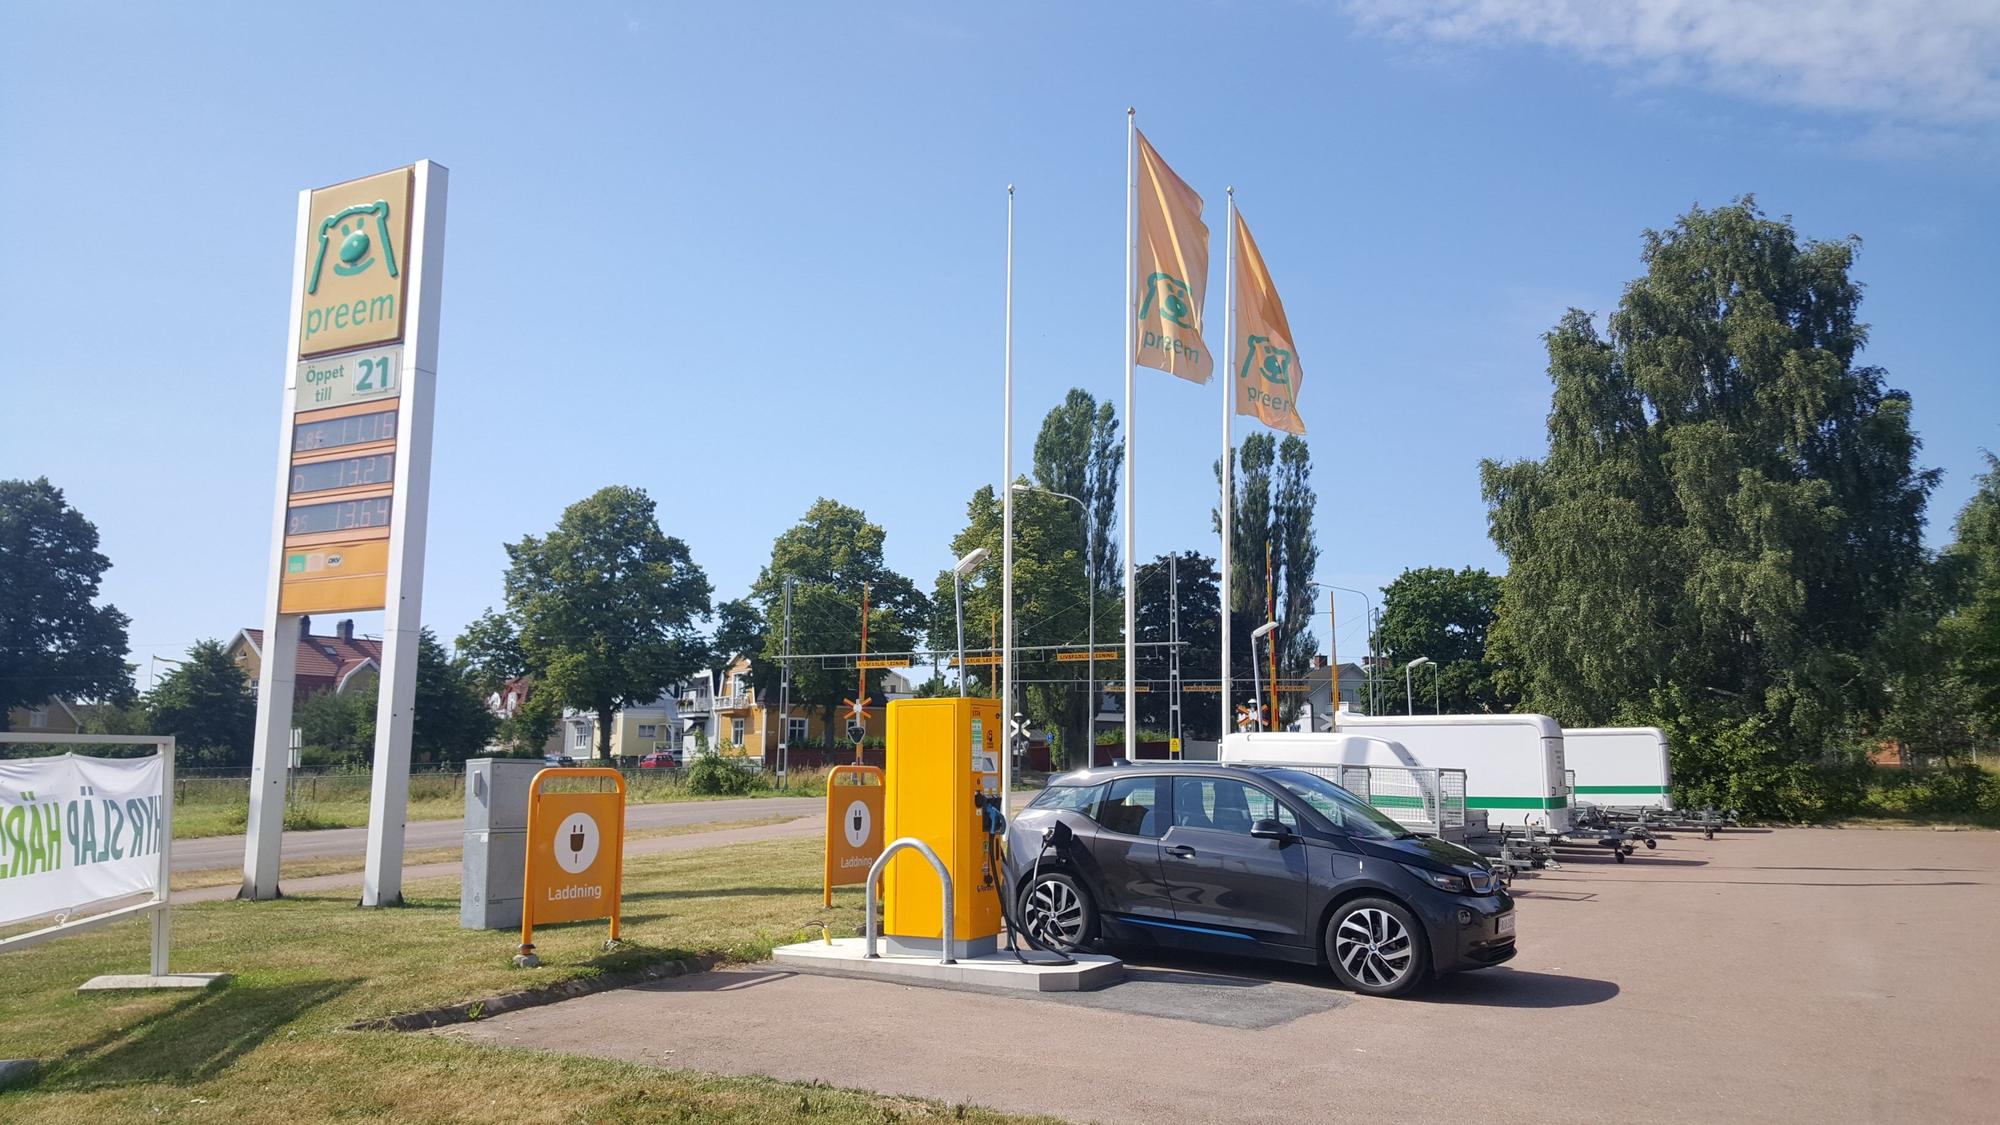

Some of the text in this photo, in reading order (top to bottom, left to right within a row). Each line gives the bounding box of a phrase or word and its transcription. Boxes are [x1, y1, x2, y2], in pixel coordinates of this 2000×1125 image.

[305, 293, 395, 341] preem
[1143, 330, 1200, 364] preem
[306, 365, 345, 386] Öppet
[356, 356, 390, 392] 21
[315, 386, 332, 402] till
[293, 455, 392, 493] D 13.27
[840, 855, 873, 869] Laddning
[548, 883, 602, 901] Laddning
